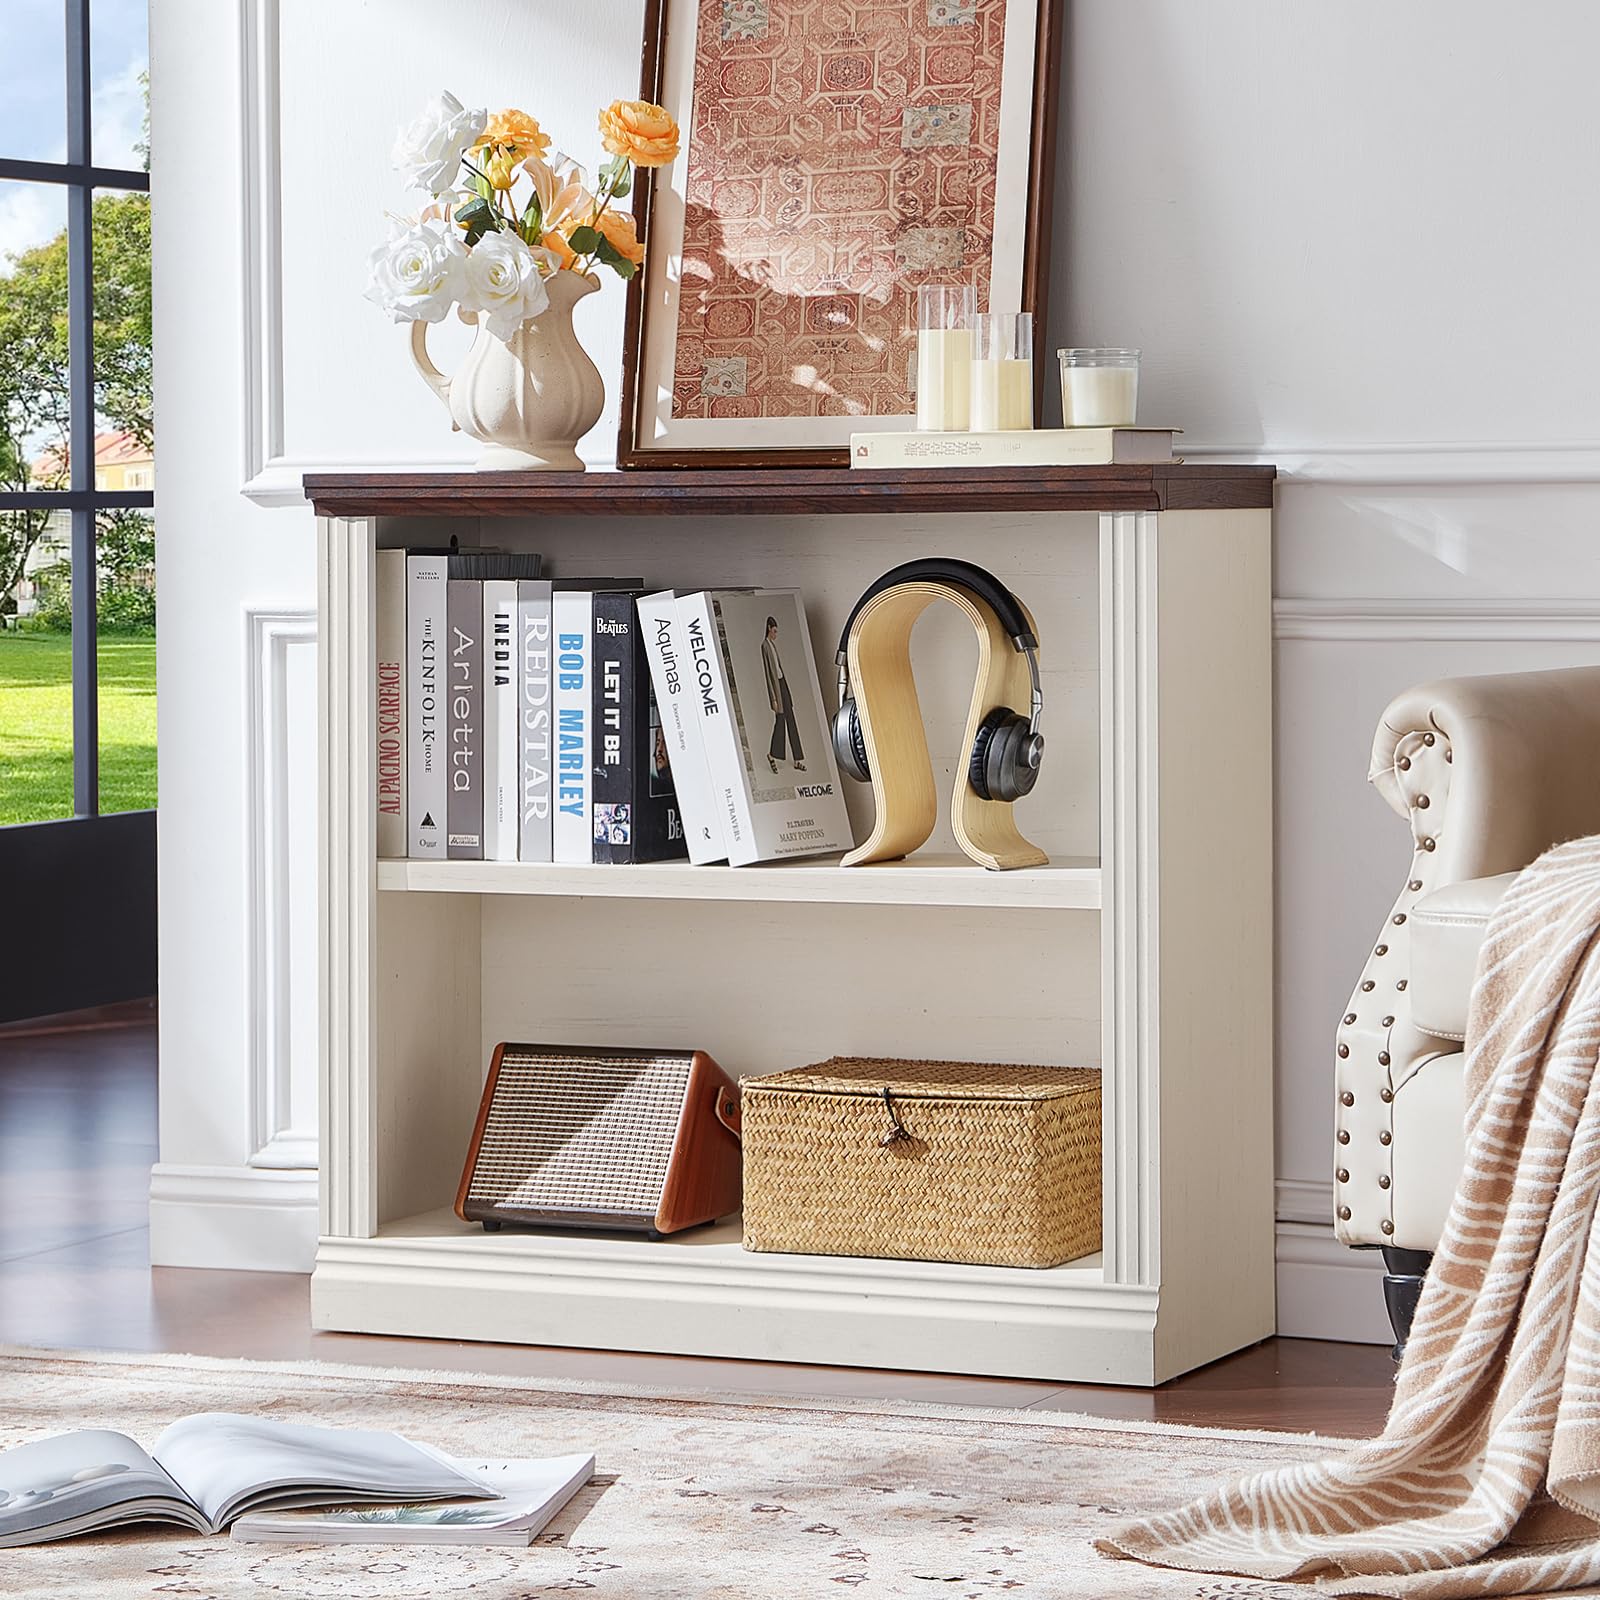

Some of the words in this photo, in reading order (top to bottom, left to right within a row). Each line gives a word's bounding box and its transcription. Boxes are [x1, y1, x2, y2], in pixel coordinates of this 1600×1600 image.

[494, 613, 510, 687] INEDIA
[558, 633, 584, 691] BOB
[604, 660, 620, 704] LET
[654, 617, 682, 695] Aquinas
[687, 617, 719, 717] WELCOME
[378, 662, 400, 734] SCARFACE
[422, 639, 435, 743] KINFOLK
[452, 626, 475, 793] Arletta
[523, 614, 549, 825] REDSTAR
[604, 709, 620, 729] IT
[379, 739, 401, 795] PACINO
[558, 710, 584, 819] MARLEY
[604, 735, 620, 766] BE
[379, 797, 401, 815] AL
[796, 784, 834, 798] WELCOME
